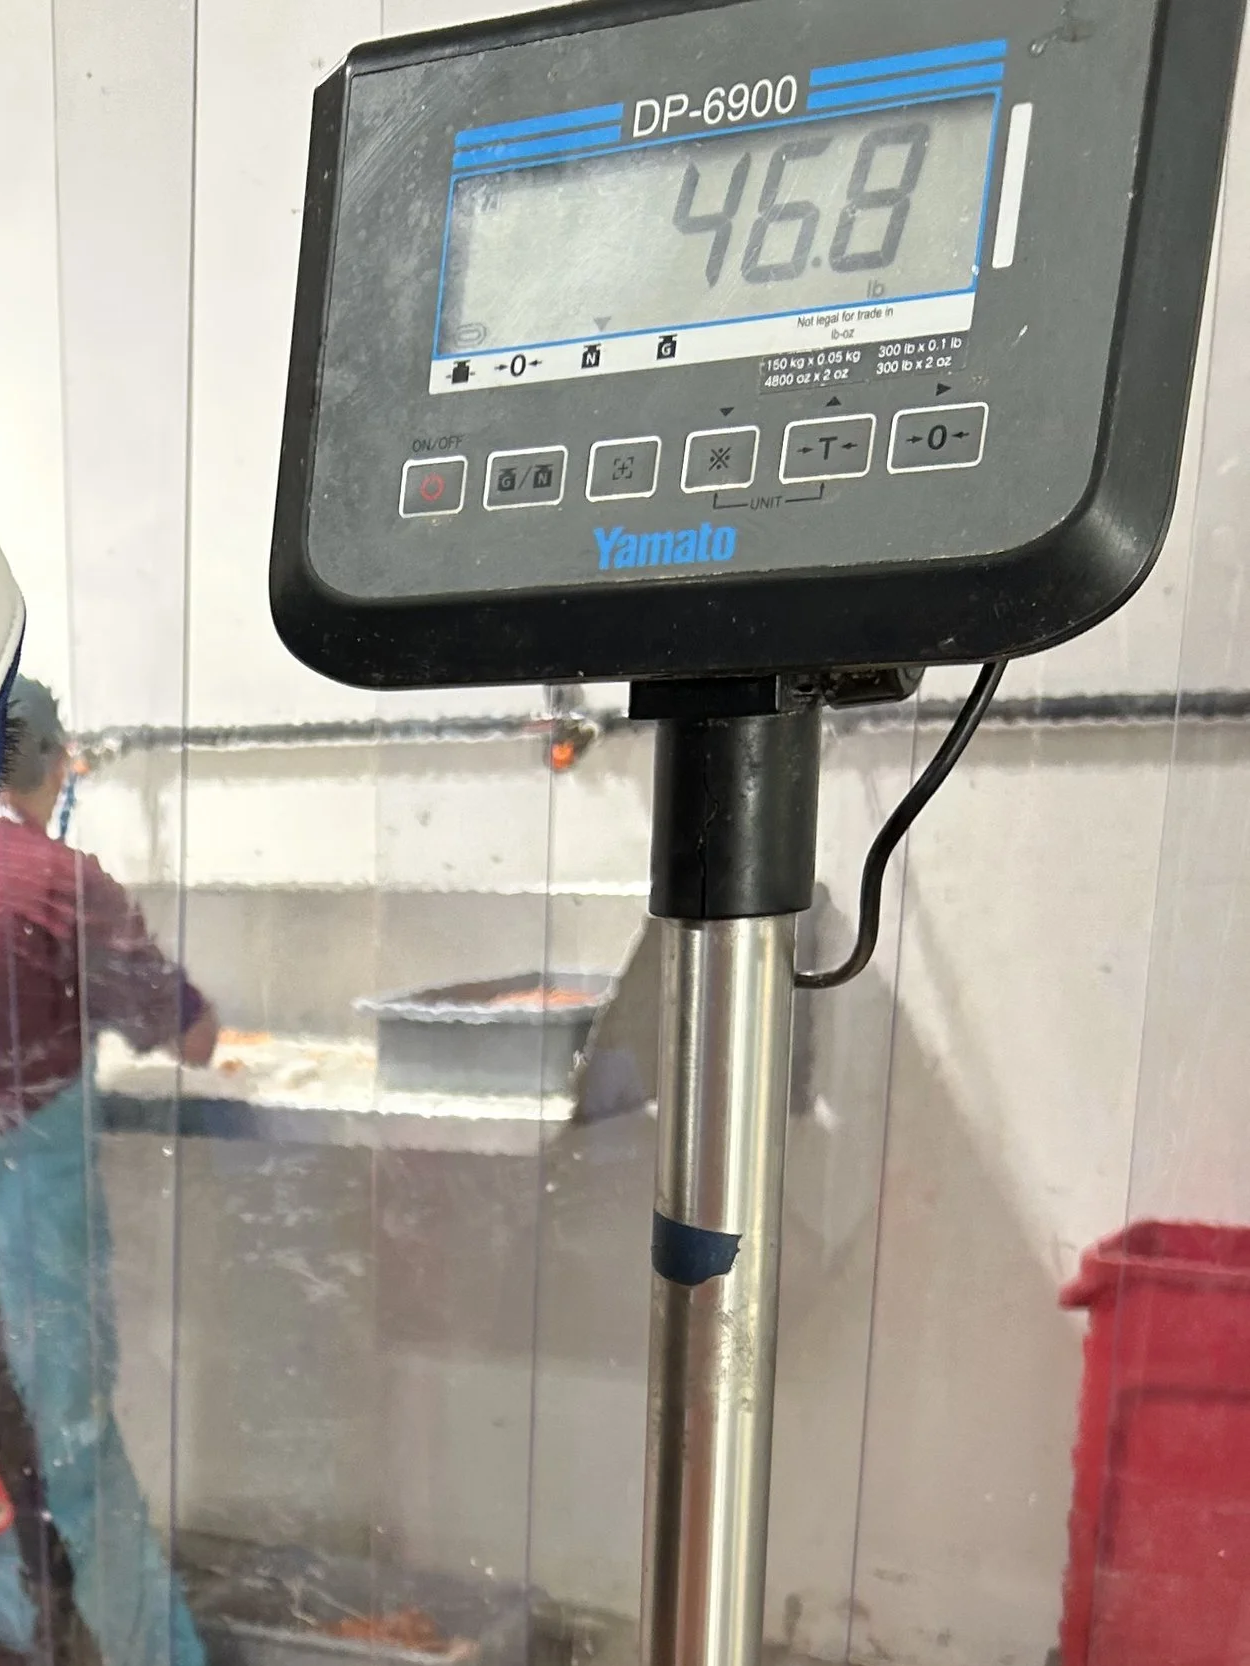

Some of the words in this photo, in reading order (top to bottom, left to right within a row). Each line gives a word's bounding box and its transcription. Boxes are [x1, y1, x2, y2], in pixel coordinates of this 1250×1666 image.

[632, 74, 798, 138] DP-6900
[672, 121, 929, 289] 46.8
[866, 279, 885, 298] lb
[797, 315, 814, 328] Not
[816, 312, 839, 329] legal
[841, 311, 855, 323] for
[857, 308, 882, 321] trade
[884, 306, 894, 318] in
[831, 327, 855, 340] lb-oz
[878, 343, 901, 359] 300
[903, 341, 915, 355] lb
[917, 342, 925, 353] x
[928, 338, 946, 352] 0.1
[950, 336, 962, 349] lb
[766, 356, 787, 372] 150
[789, 354, 805, 370] kg
[807, 356, 815, 367] x
[817, 351, 843, 366] 0.05
[845, 349, 861, 364] kg
[876, 359, 899, 375] 300
[901, 357, 913, 371] lb
[915, 359, 923, 370] x
[924, 356, 933, 369] 2
[936, 354, 952, 368] oz
[764, 371, 794, 388] 4800
[796, 371, 812, 385] oz
[814, 371, 821, 382] x
[822, 368, 831, 381] 2
[833, 367, 849, 380] oz
[412, 434, 464, 452] ON/OFF
[750, 495, 783, 510] UNIT
[593, 521, 738, 571] Yamato
